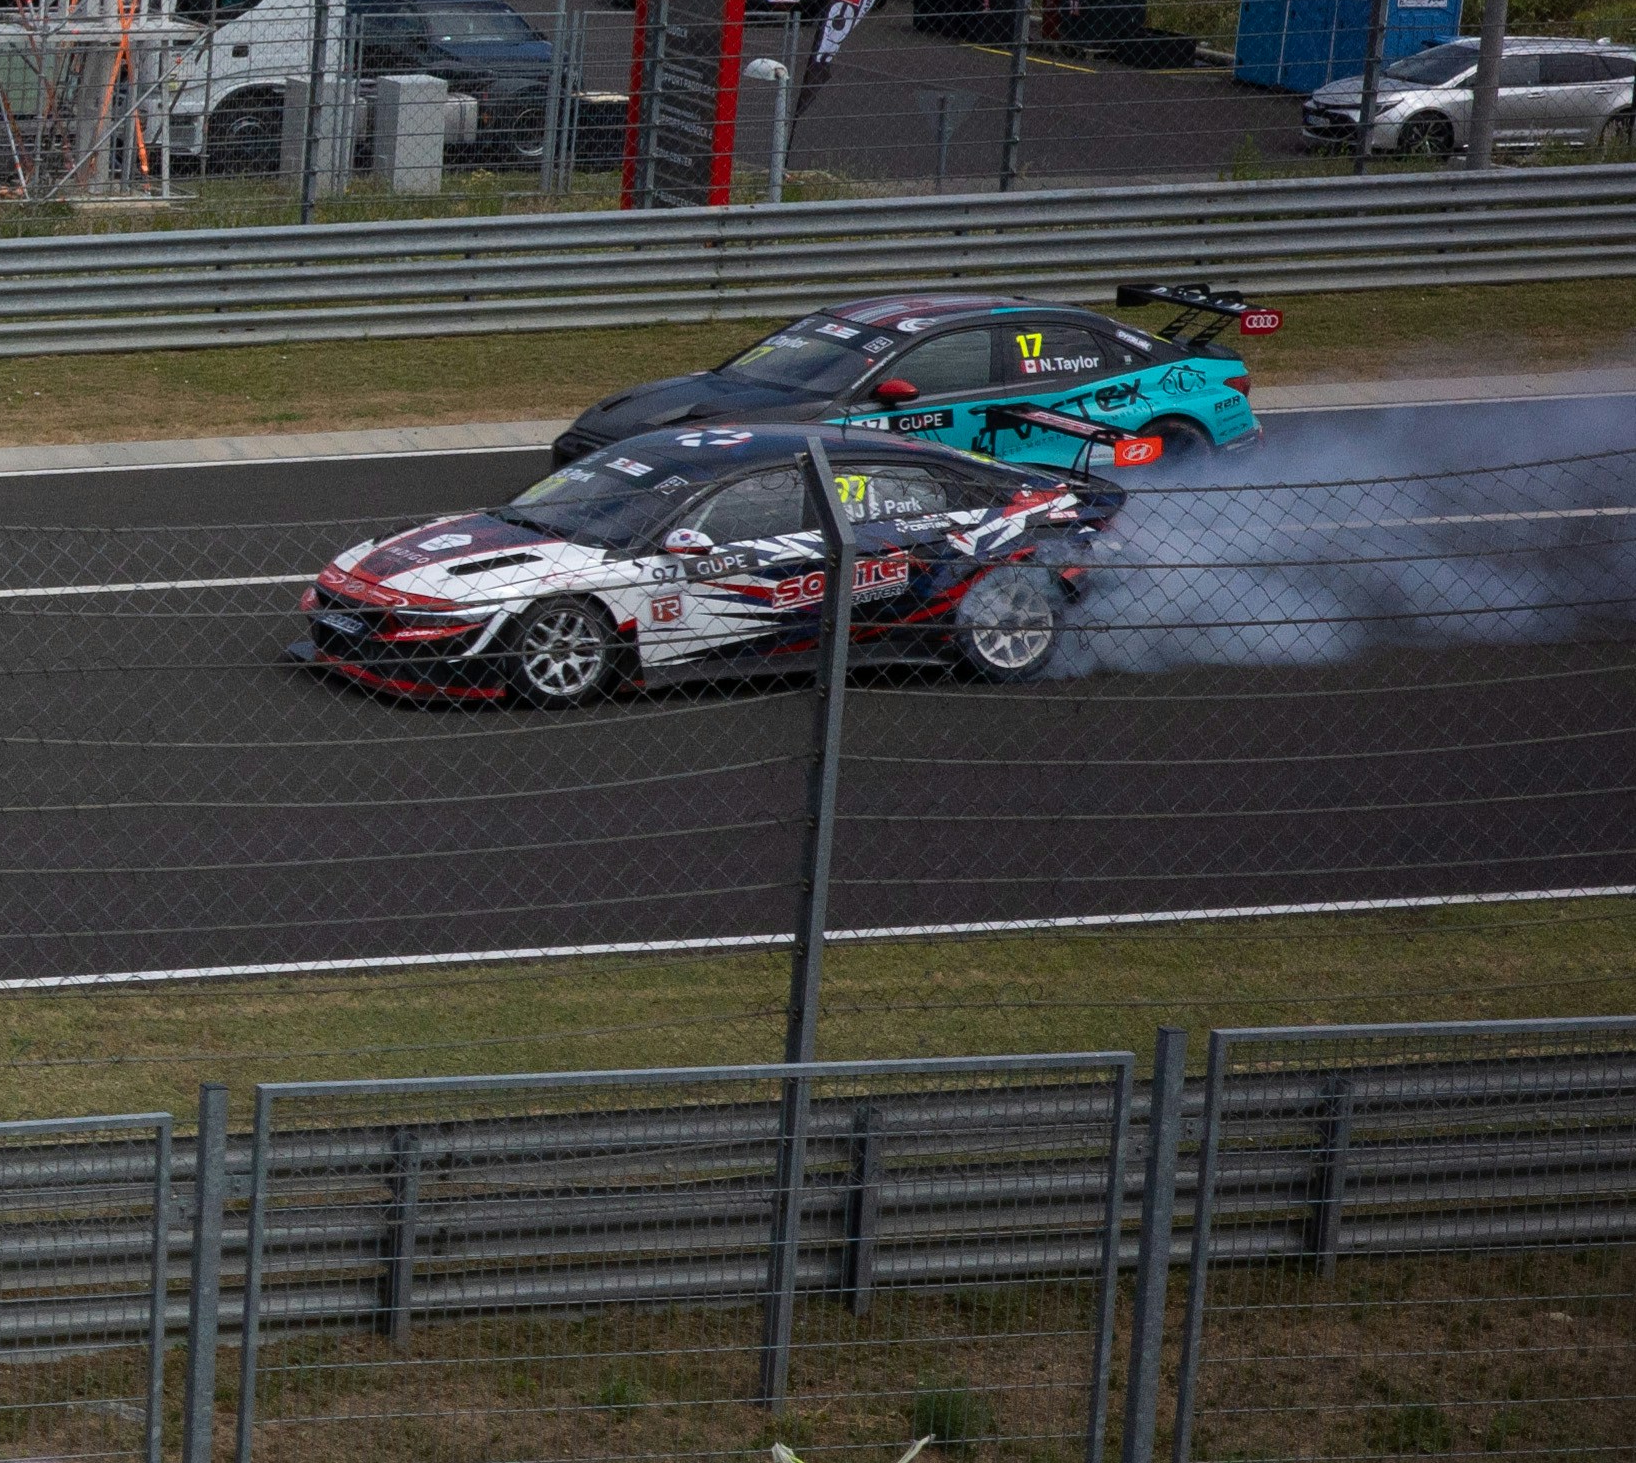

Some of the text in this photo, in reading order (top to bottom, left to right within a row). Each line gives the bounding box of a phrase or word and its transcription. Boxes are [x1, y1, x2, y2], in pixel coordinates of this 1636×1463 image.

[1015, 333, 1043, 358] 17
[1040, 354, 1099, 372] N.Taylor
[884, 497, 922, 515] Park
[652, 564, 678, 585] 97
[653, 599, 681, 620] TR
